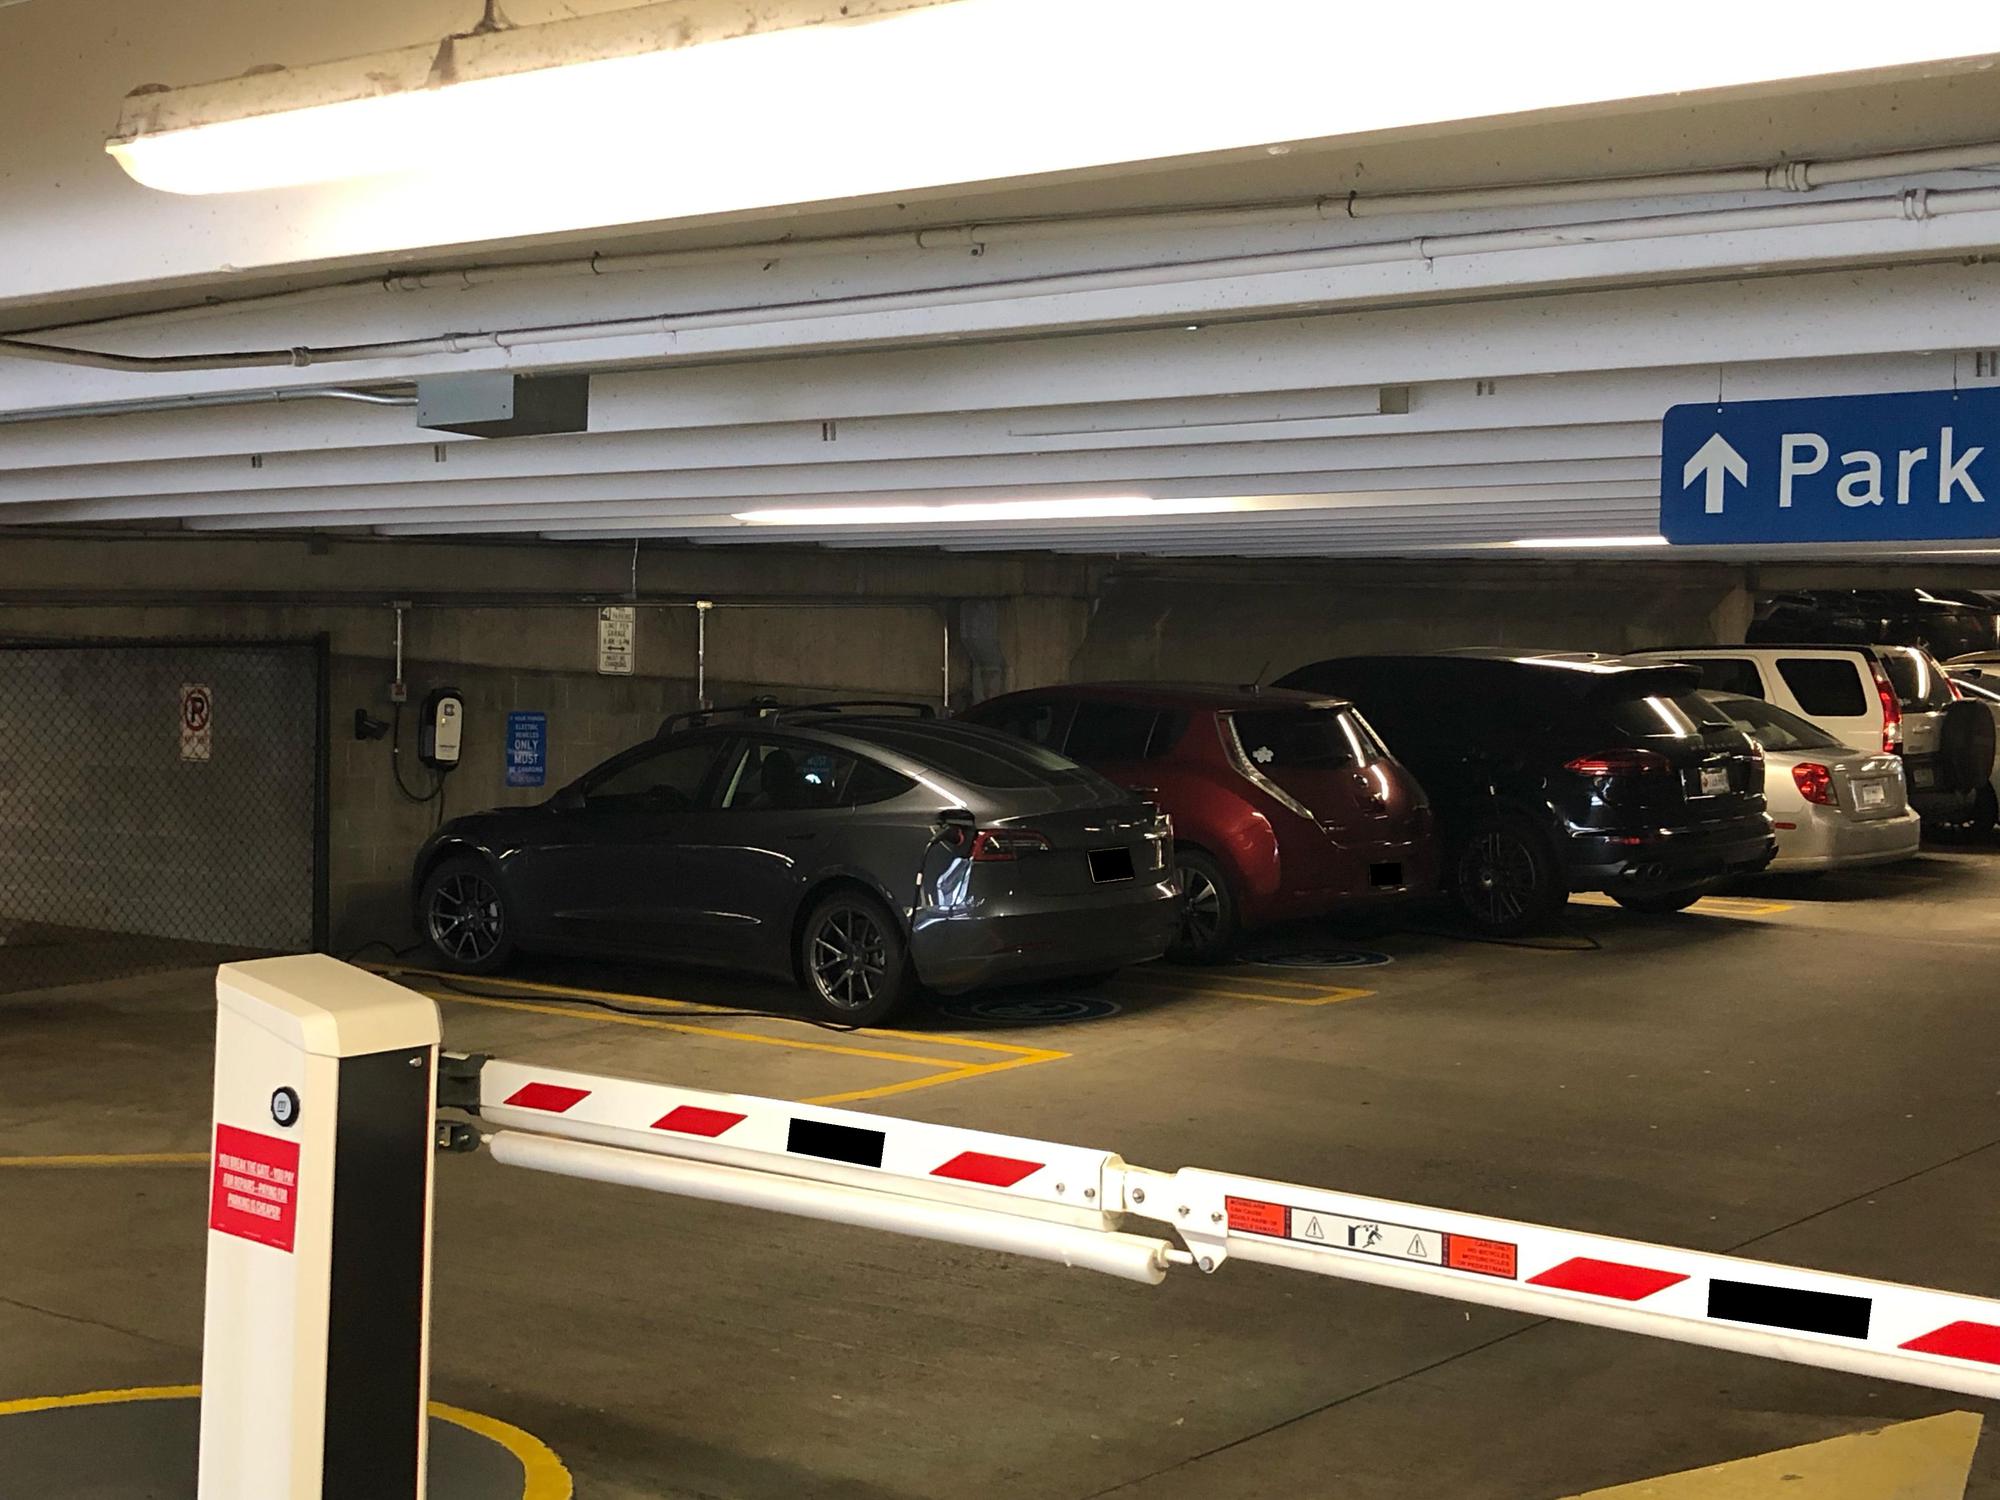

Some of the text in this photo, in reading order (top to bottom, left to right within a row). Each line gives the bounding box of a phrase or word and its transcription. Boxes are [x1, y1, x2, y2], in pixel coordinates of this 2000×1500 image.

[1779, 427, 1985, 508] Park
[514, 740, 538, 751] ONLY
[514, 753, 539, 765] MUST
